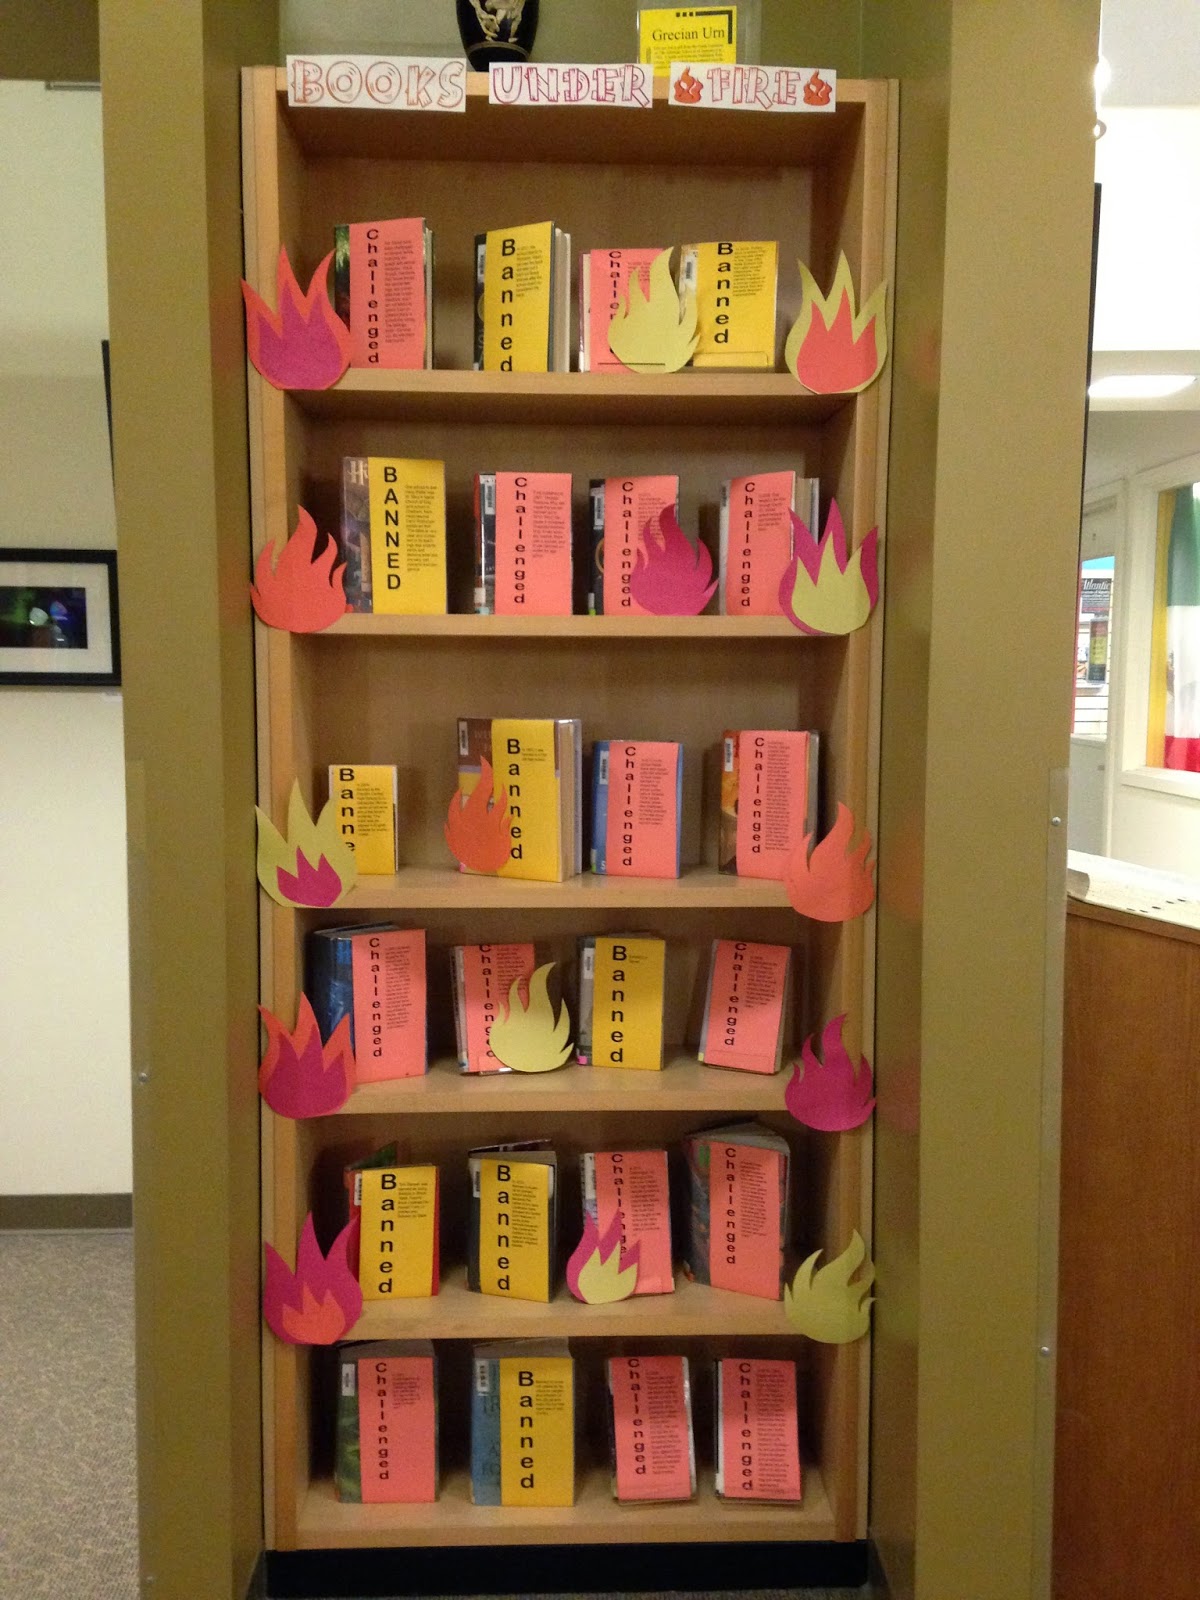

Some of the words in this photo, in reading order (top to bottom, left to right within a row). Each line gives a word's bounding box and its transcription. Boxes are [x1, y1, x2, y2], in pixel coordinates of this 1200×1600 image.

[290, 58, 466, 110] BOOKS
[491, 63, 650, 107] UNDER
[706, 67, 804, 110] FIRE
[652, 28, 699, 42] Grecian
[702, 26, 726, 39] Urn
[366, 229, 380, 364] Challenged
[501, 238, 516, 372] Banned
[714, 242, 734, 344] Banned
[383, 466, 401, 590] BANNED
[514, 477, 528, 603] Challenged
[621, 481, 633, 607] Challenged
[741, 482, 756, 607] Challenged
[339, 767, 356, 852] Banne
[507, 738, 523, 860] Banned
[622, 746, 636, 867] Challenged
[752, 737, 765, 854] Challenged
[369, 937, 382, 1058] Challenged
[479, 944, 495, 1058] Challeng
[609, 945, 628, 1063] Banned
[724, 942, 748, 1046] Challenged
[378, 1173, 397, 1294] Banned
[497, 1164, 512, 1291] Banned
[611, 1154, 627, 1258] Challenge
[725, 1147, 737, 1265] Challenged
[375, 1362, 389, 1480] Challenged
[518, 1370, 534, 1489] Banned
[627, 1358, 646, 1475] Challenged
[738, 1362, 753, 1491] Challenged
